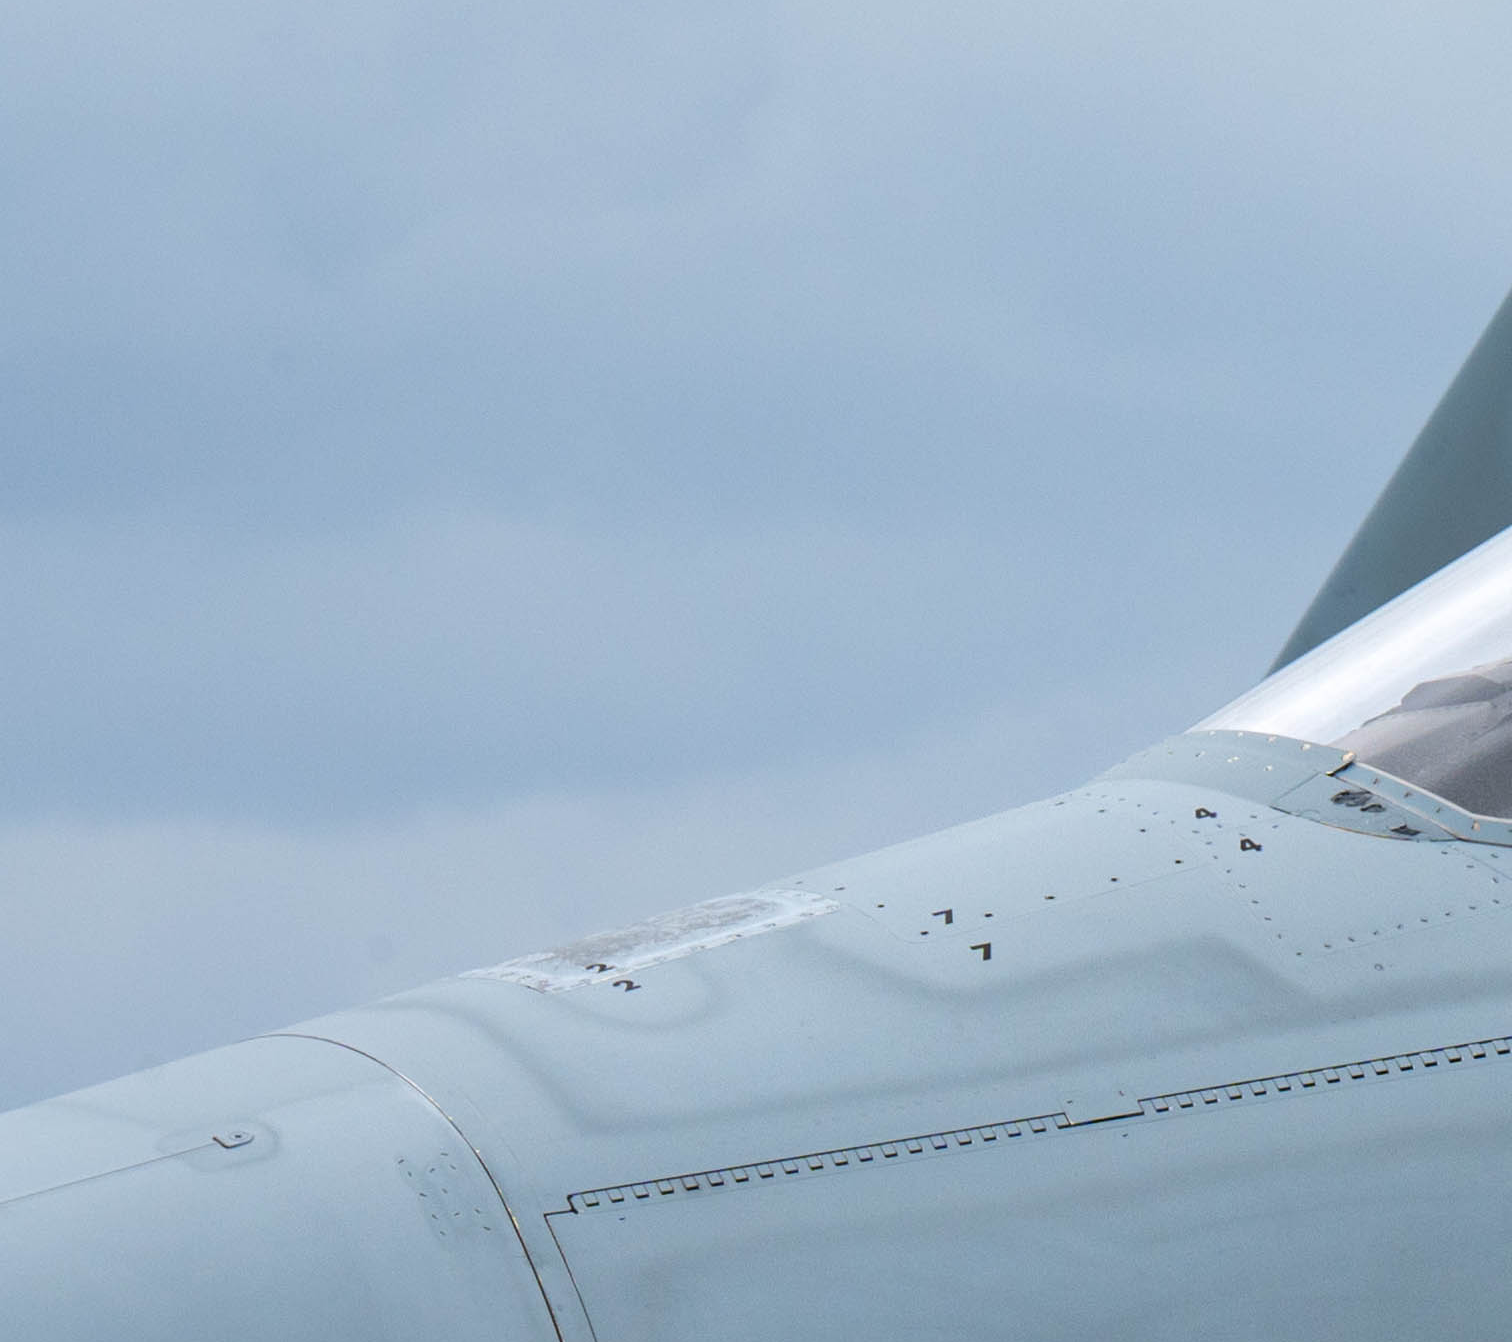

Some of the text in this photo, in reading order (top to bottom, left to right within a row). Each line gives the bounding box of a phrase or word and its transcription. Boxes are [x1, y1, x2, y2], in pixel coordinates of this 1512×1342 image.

[1240, 838, 1262, 851] 4
[970, 942, 992, 961] 7
[612, 979, 641, 992] 2
